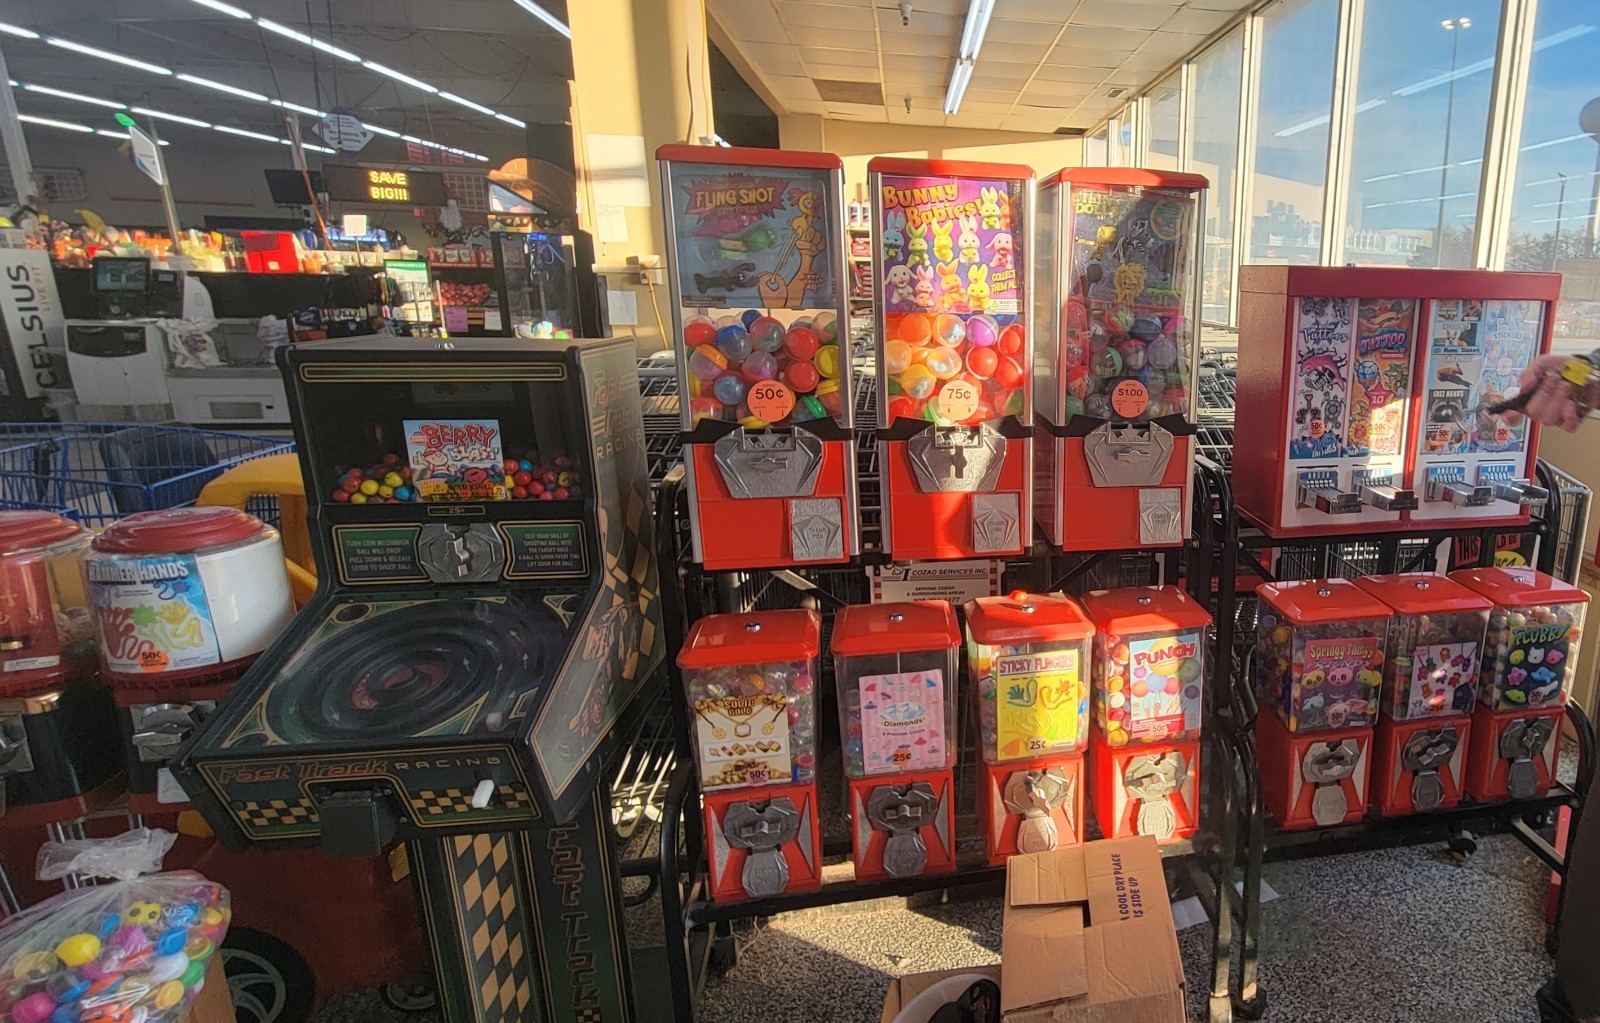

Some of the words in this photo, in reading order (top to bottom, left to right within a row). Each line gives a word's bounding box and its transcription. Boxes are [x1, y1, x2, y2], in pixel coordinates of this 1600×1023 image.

[368, 171, 408, 185] SAVE
[372, 188, 408, 200] BIG!!!
[696, 188, 738, 208] FLING
[739, 187, 776, 205] SHOT
[904, 198, 982, 230] Babies!
[991, 269, 1016, 282] COLLECT
[990, 282, 1008, 294] THEM
[39, 286, 52, 312] LIVE
[7, 264, 59, 389] CELSIUS
[1302, 327, 1349, 344] Tattoos
[1361, 332, 1406, 350] TATTOO
[756, 388, 784, 400] 50¢
[947, 388, 971, 399] 75¢
[1118, 388, 1142, 396] $1.00
[1371, 396, 1384, 404] 10
[420, 423, 496, 449] BERRY
[448, 445, 500, 461] BLAST
[1458, 536, 1479, 561] THIS
[140, 561, 189, 582] HANDS
[1512, 624, 1571, 645] FLUBBY
[142, 651, 162, 660] 50¢
[1134, 642, 1197, 666] PUNCH
[1310, 644, 1345, 660] Springy
[1000, 658, 1032, 674] STICKY
[724, 699, 755, 709] SOLID
[728, 707, 752, 716] GOLD
[884, 719, 923, 727] Diamonds
[1152, 725, 1165, 733] 50¢
[1030, 741, 1046, 750] 25¢
[894, 753, 912, 762] 25¢
[218, 764, 290, 785] Fast
[298, 758, 388, 780] Track
[394, 756, 500, 770] RACING
[750, 770, 765, 778] 50¢
[1112, 853, 1123, 875] PLACE
[1115, 877, 1125, 891] DRY
[1128, 877, 1138, 886] UP
[1117, 893, 1129, 914] COOL
[1130, 889, 1142, 907] SIDE
